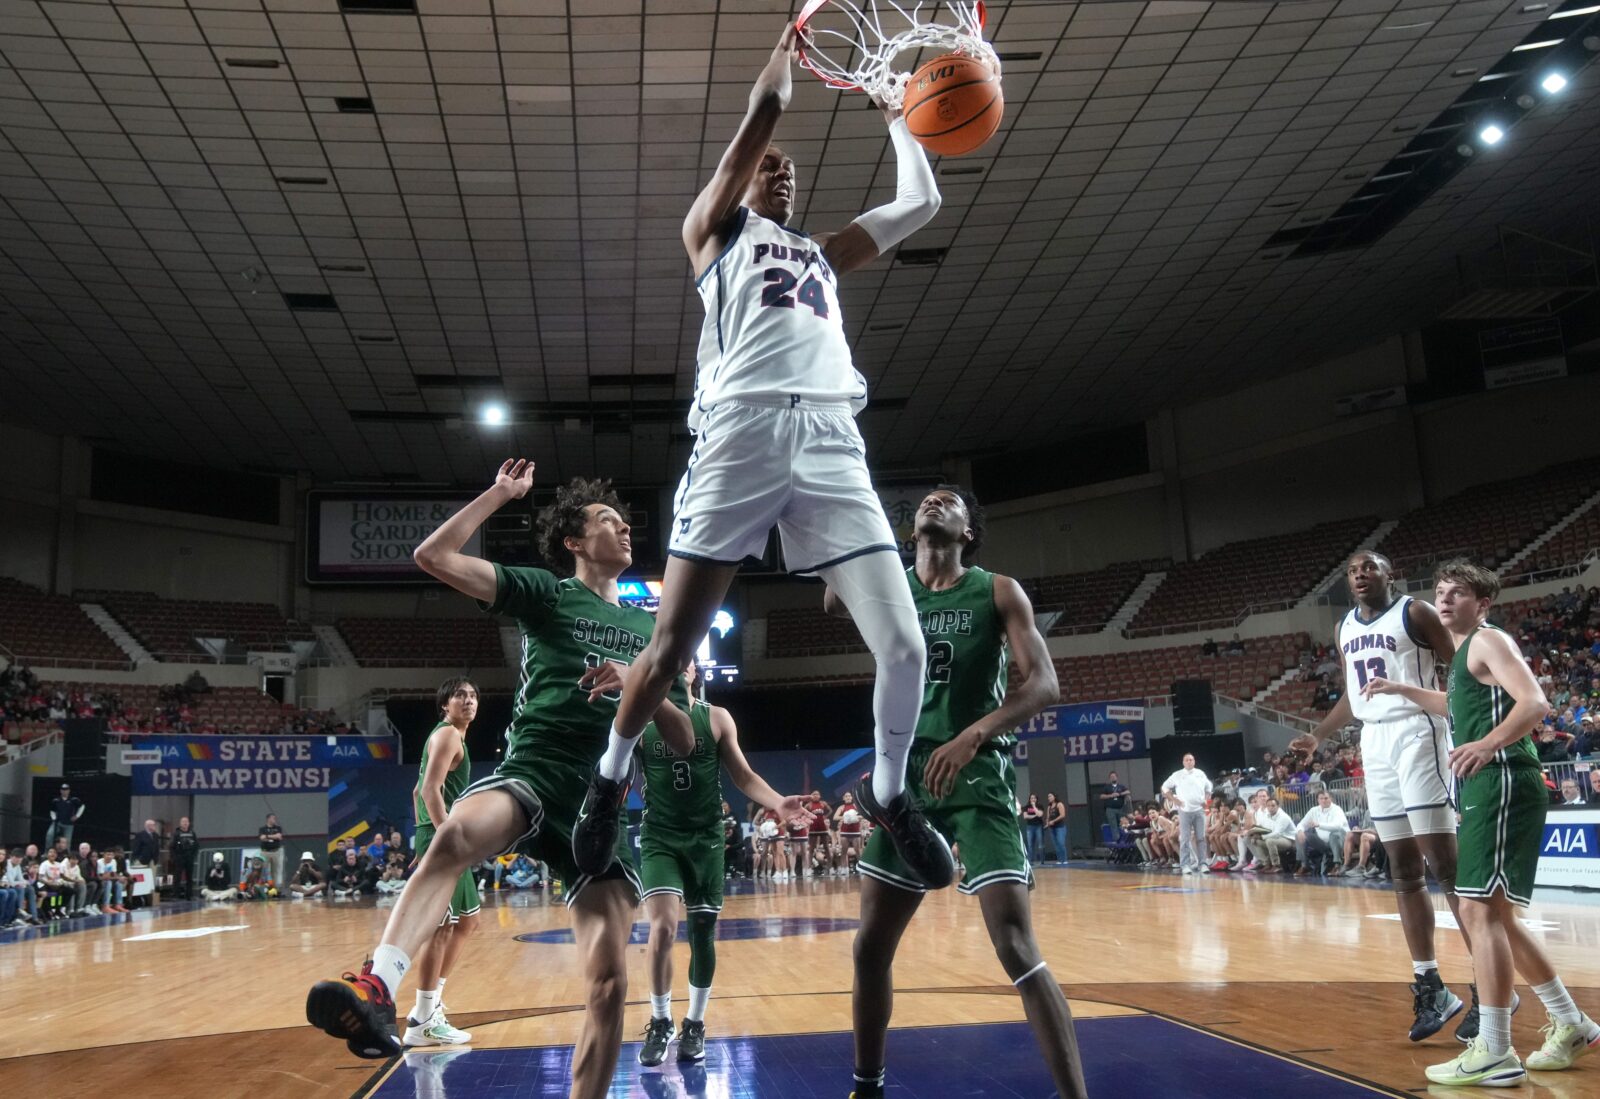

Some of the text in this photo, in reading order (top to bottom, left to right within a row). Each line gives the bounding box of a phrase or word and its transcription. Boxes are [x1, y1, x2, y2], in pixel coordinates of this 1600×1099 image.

[761, 267, 829, 320] 24
[790, 394, 801, 409] P
[351, 503, 425, 522] HOME
[350, 521, 438, 541] GARDE
[573, 617, 645, 658] SLOPE
[1343, 633, 1397, 656] PUMAS
[1078, 713, 1104, 725] AIA
[219, 741, 312, 761] STATE
[332, 745, 360, 757] AIA
[672, 761, 692, 791] 3
[1544, 828, 1587, 853] AIA
